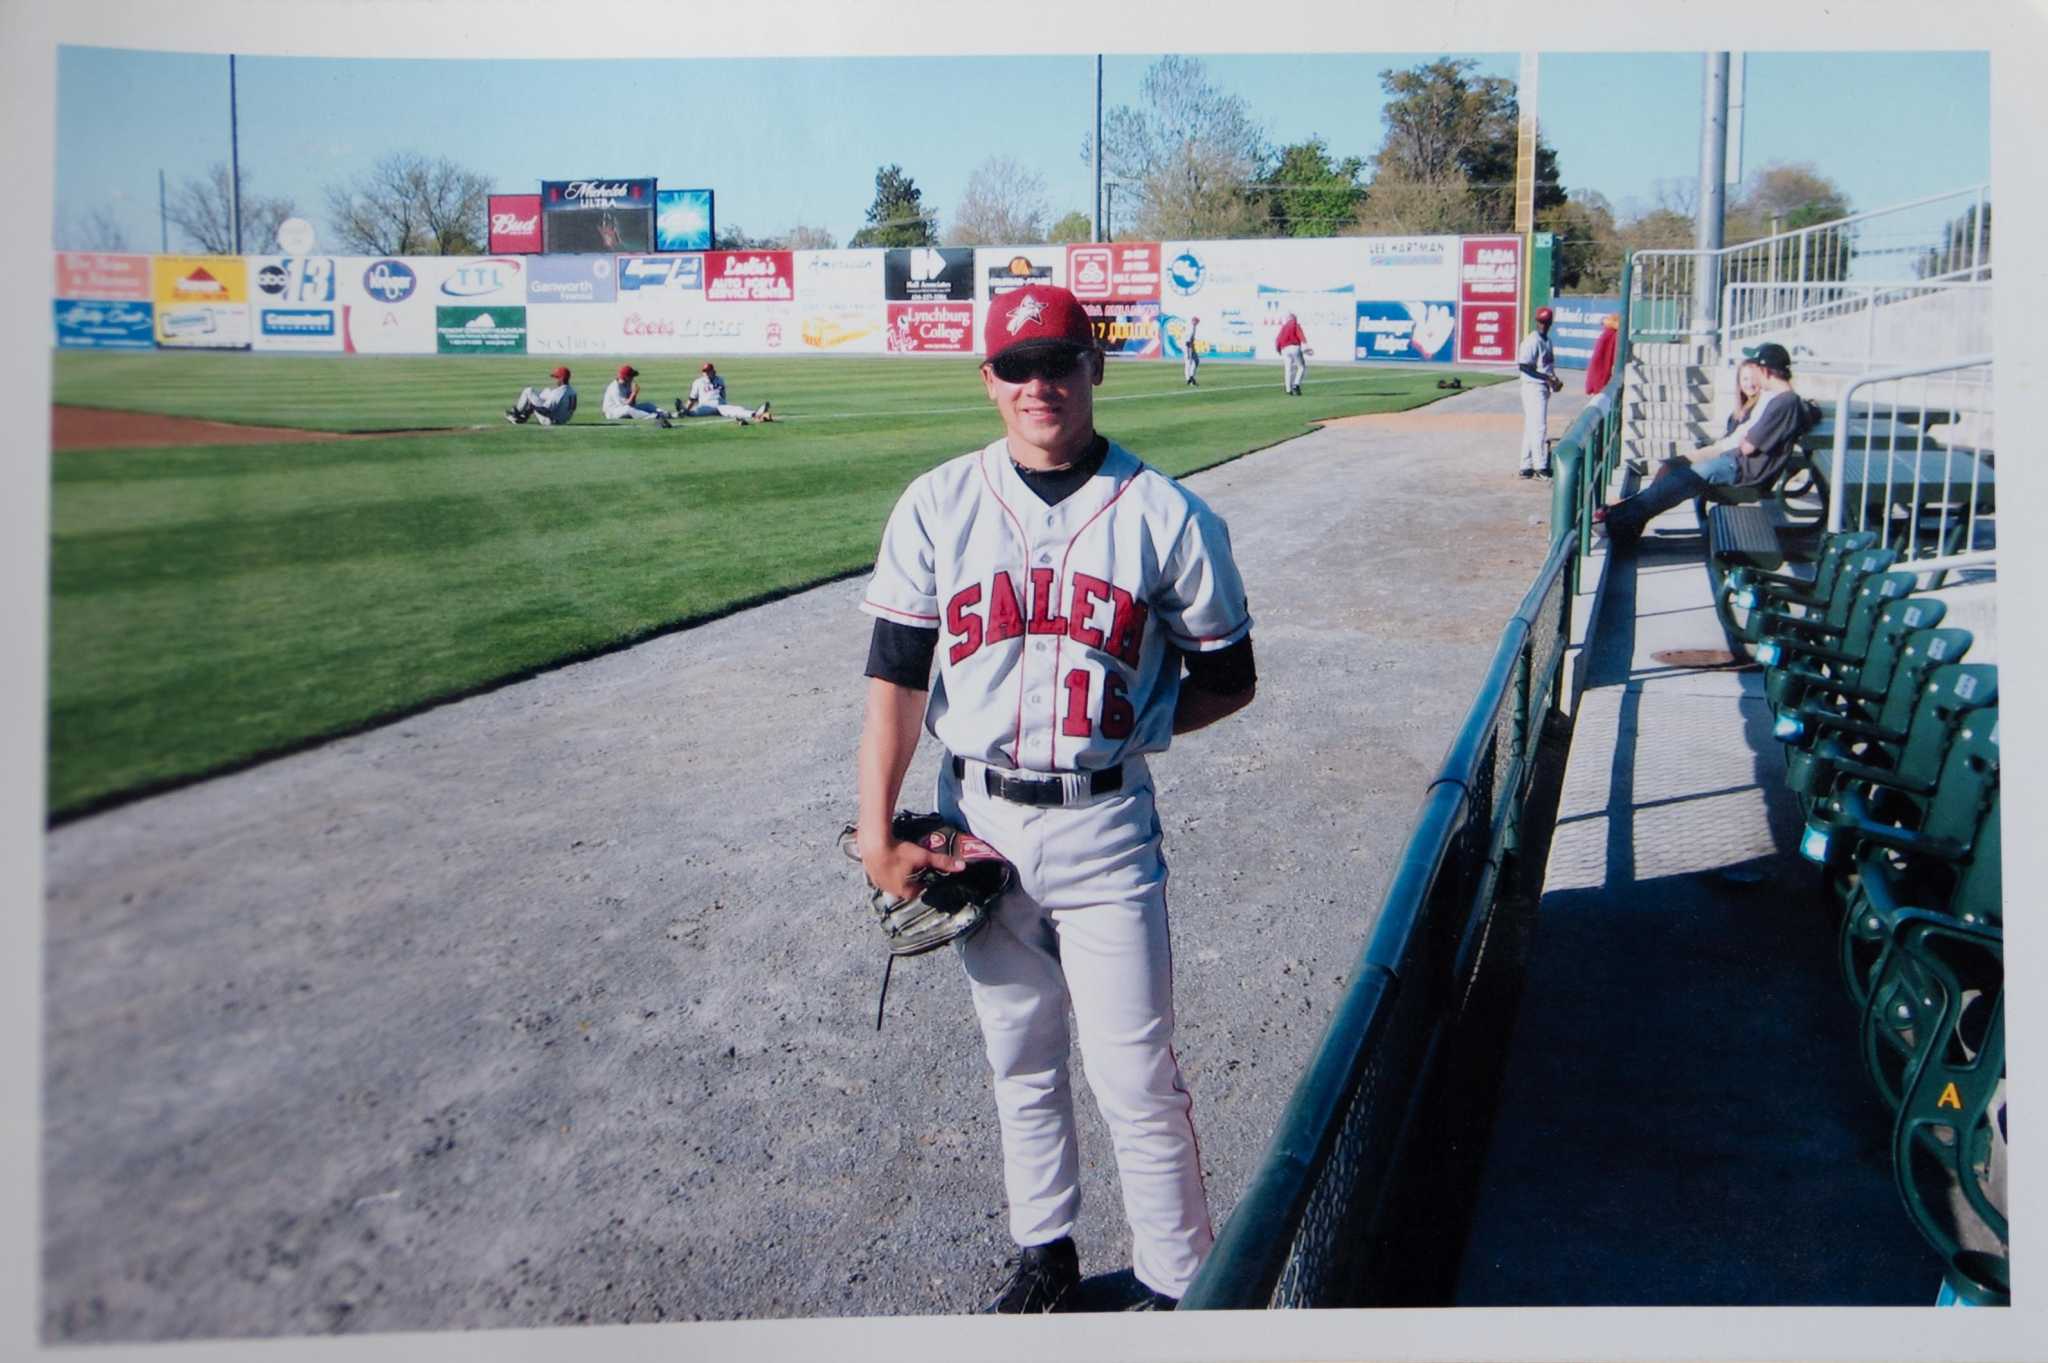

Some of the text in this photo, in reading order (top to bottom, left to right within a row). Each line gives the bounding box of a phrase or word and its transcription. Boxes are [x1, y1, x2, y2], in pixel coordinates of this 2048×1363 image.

[564, 181, 628, 199] Michelob
[580, 198, 617, 208] ULTRA
[492, 214, 538, 234] Bud
[1477, 249, 1516, 264] FARM
[457, 267, 502, 288] TTL
[1463, 264, 1516, 280] BUREAU
[711, 277, 742, 289] AUTO
[907, 306, 970, 326] Lynchburg
[920, 323, 964, 343] College
[946, 568, 1149, 671] SALEM
[1062, 668, 1135, 740] 16
[1937, 1082, 1962, 1109] A
